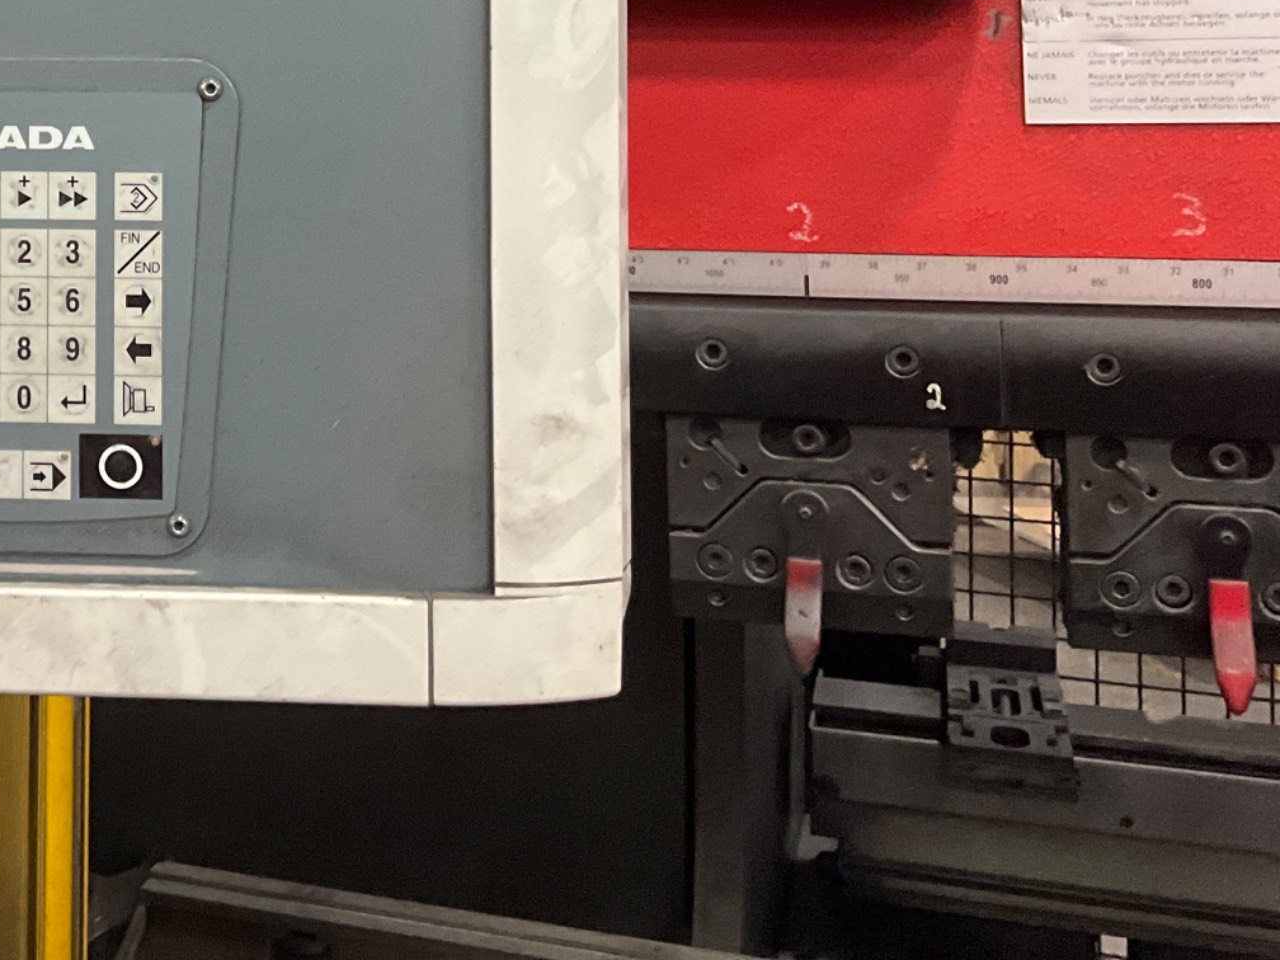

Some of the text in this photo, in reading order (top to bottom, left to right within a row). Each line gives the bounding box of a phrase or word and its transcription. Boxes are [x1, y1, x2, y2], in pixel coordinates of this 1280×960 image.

[786, 202, 820, 242] 2
[1172, 192, 1206, 237] 3
[120, 232, 141, 244] FIN
[17, 239, 32, 264] 2
[65, 239, 80, 264] 3
[134, 262, 161, 274] END
[989, 274, 1009, 285] 900
[1191, 278, 1213, 289] 800
[17, 287, 32, 312] 5
[65, 288, 80, 313] 6
[17, 336, 32, 361] 8
[65, 336, 80, 361] 9
[17, 385, 32, 410] 0
[926, 382, 947, 411] 2
